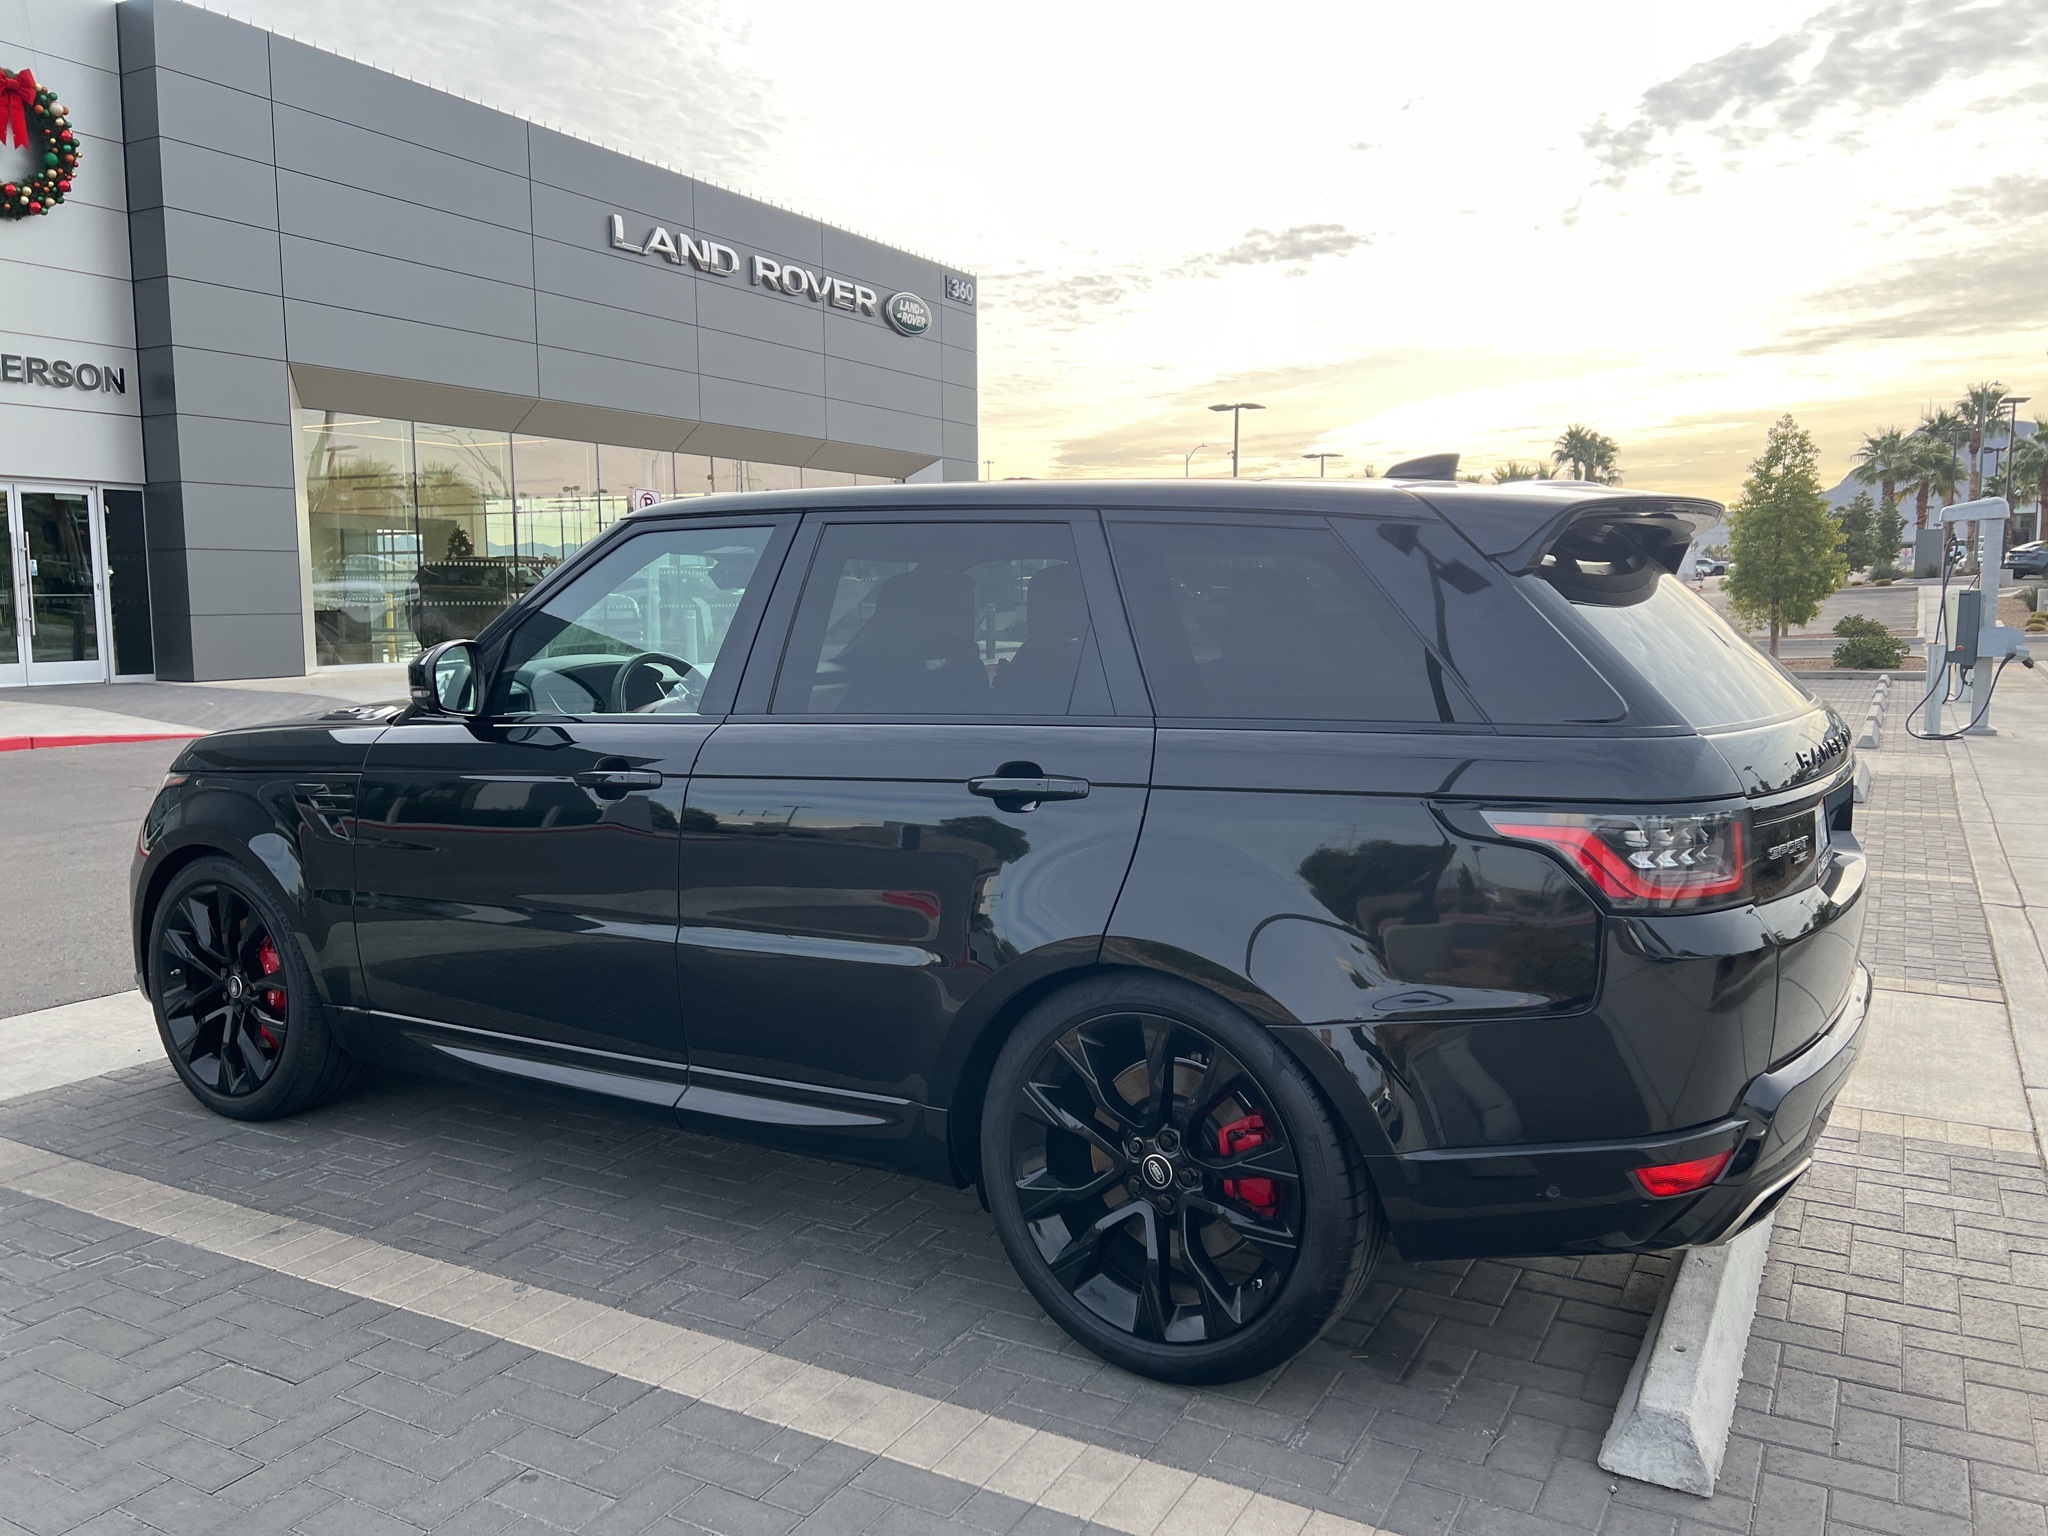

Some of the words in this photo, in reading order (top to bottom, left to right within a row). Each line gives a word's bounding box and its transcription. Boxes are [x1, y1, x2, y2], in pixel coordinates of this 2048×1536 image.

[610, 213, 740, 277] LAND
[752, 254, 877, 318] ROVER
[951, 279, 974, 302] 360
[899, 299, 920, 314] LAND
[901, 312, 926, 328] ROVER
[0, 353, 126, 394] ERSON
[1768, 835, 1809, 861] SPORT
